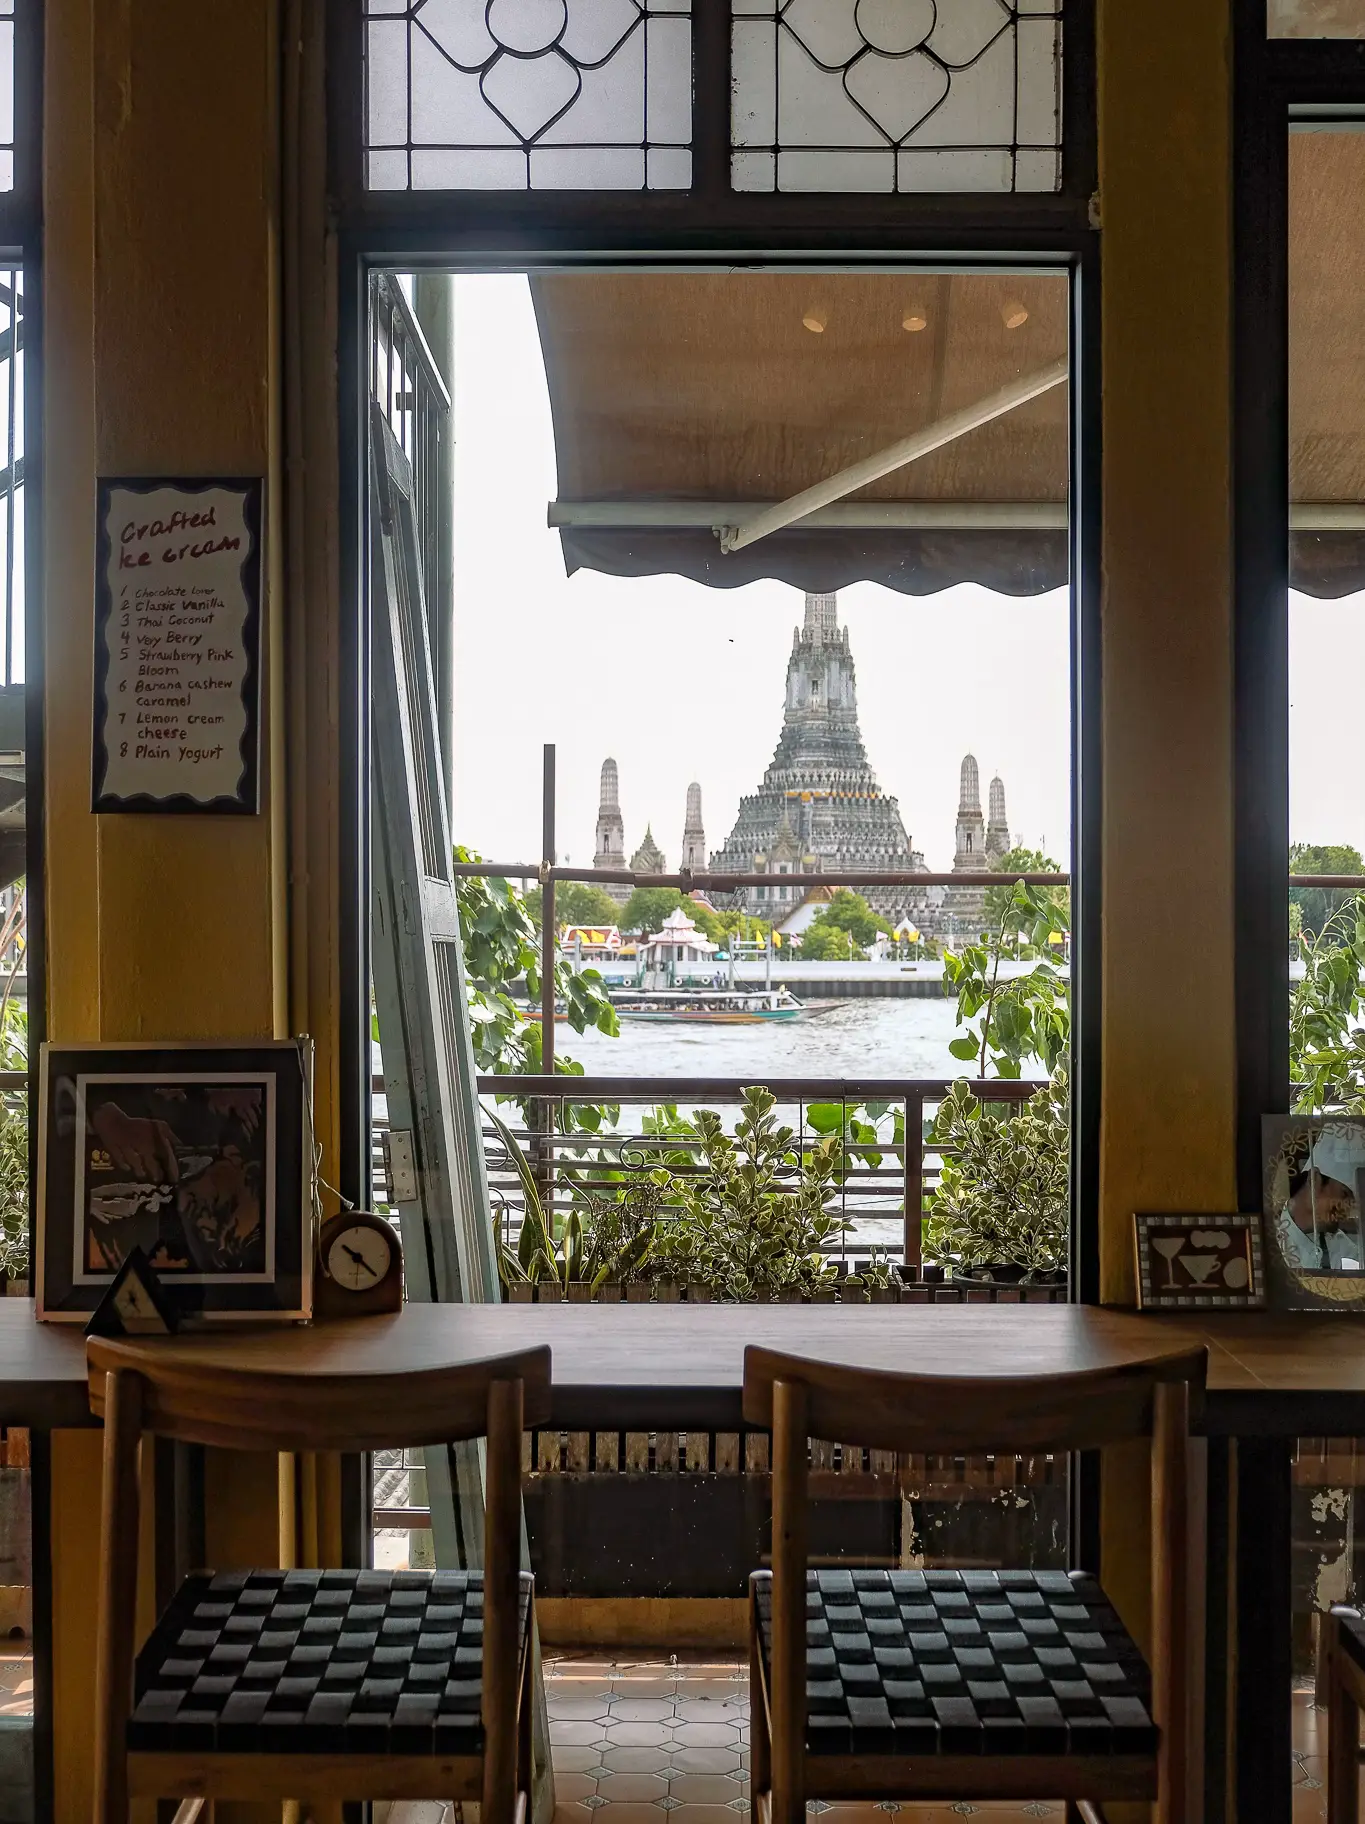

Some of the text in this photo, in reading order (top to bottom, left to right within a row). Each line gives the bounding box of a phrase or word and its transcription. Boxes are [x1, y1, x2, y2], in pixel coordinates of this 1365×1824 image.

[120, 506, 216, 543] Crafted
[135, 585, 187, 598] Chocolate
[120, 598, 225, 612] 2 Classic Vanilla
[121, 613, 215, 628] 3 Thai Coconut
[120, 631, 130, 644] 4
[166, 630, 202, 646] Berry
[120, 648, 234, 665] 5 Strawberry Pink
[138, 665, 179, 676] Bloom
[119, 679, 127, 692] 6
[118, 713, 126, 725] 7
[136, 712, 179, 725] Lemon
[119, 741, 128, 758] 8
[135, 745, 170, 759] Plain
